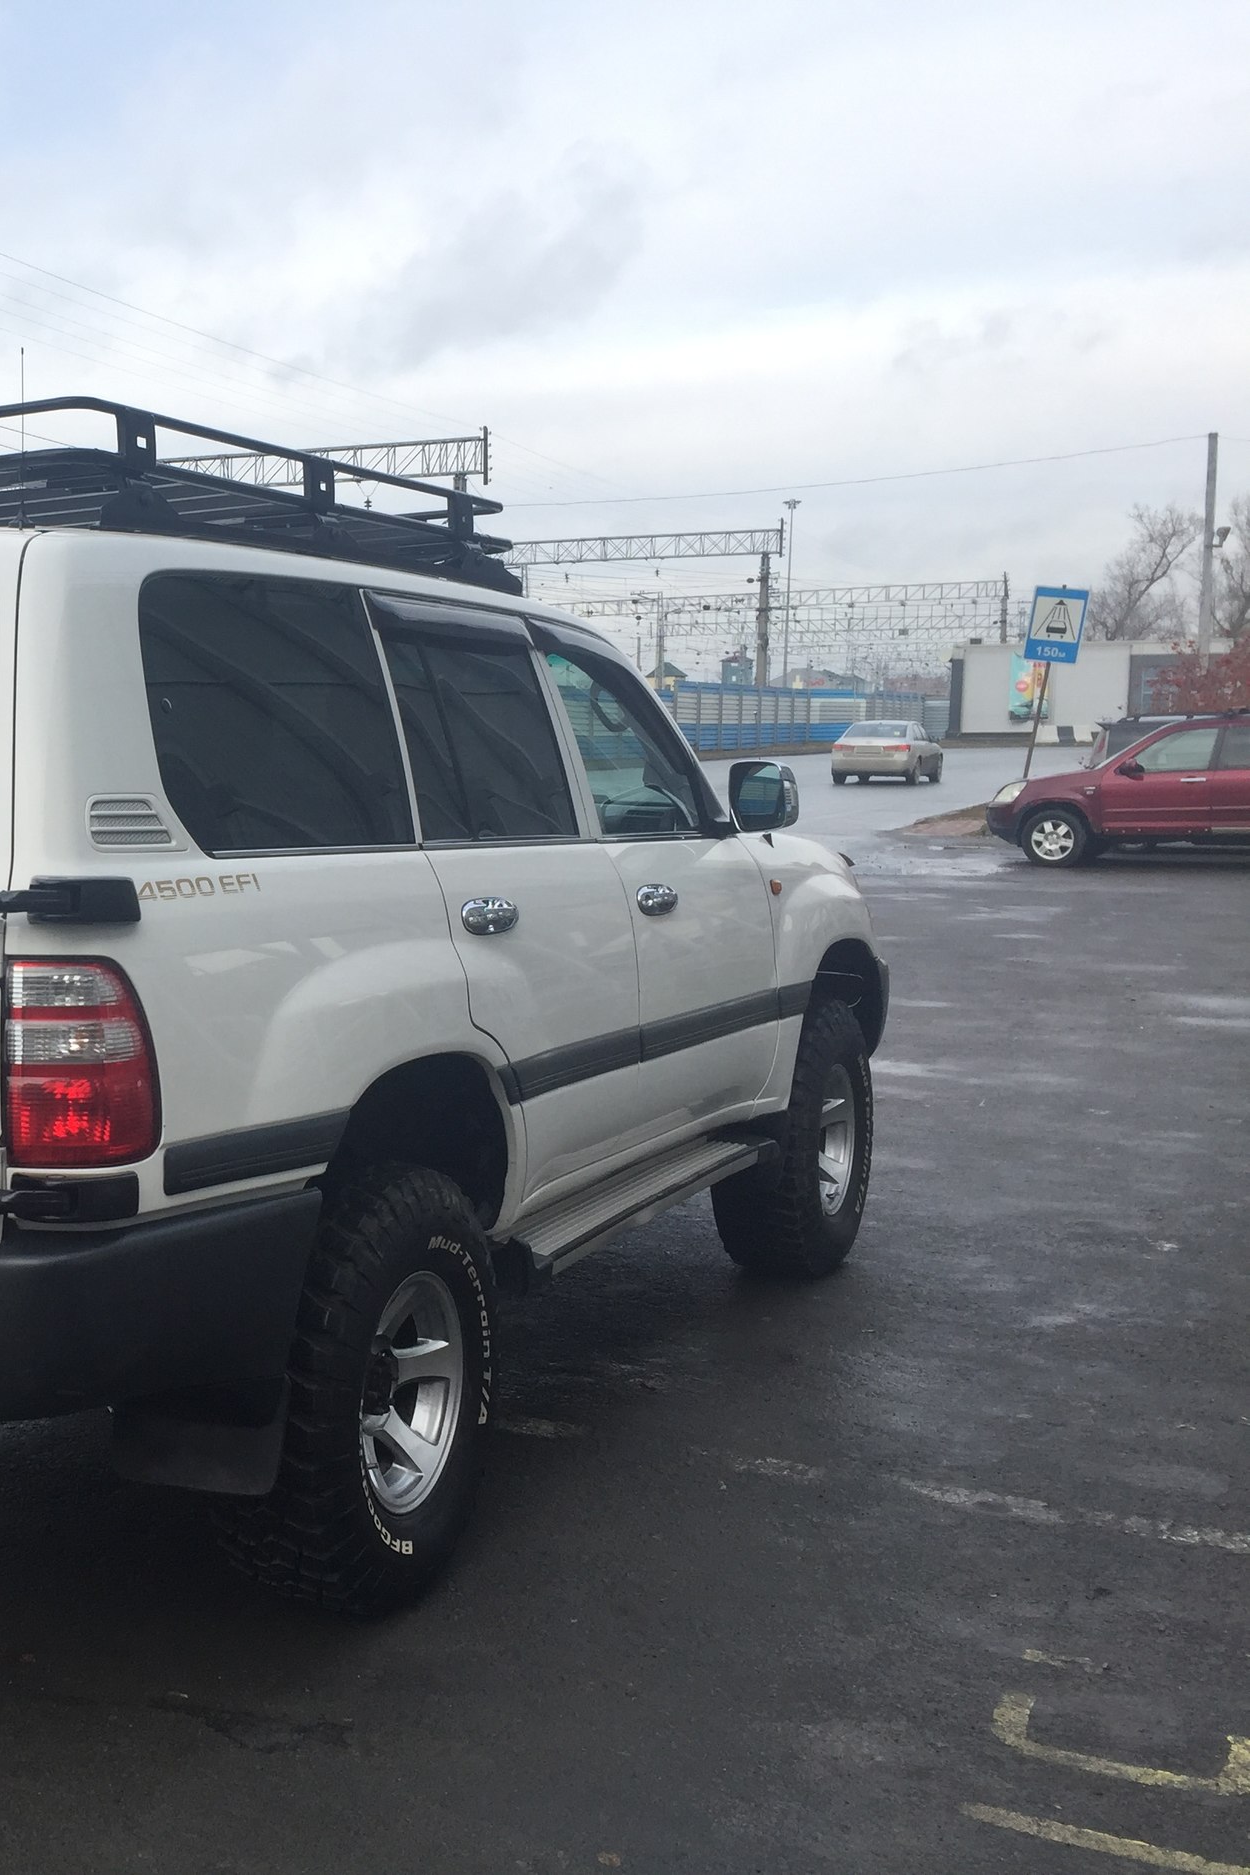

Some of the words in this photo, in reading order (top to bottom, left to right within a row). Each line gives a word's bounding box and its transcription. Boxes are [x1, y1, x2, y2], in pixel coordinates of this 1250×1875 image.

[137, 876, 216, 901] 4500
[218, 873, 261, 894] EFI
[427, 1235, 491, 1358] Mud-Terrain
[477, 1366, 492, 1425] T/A
